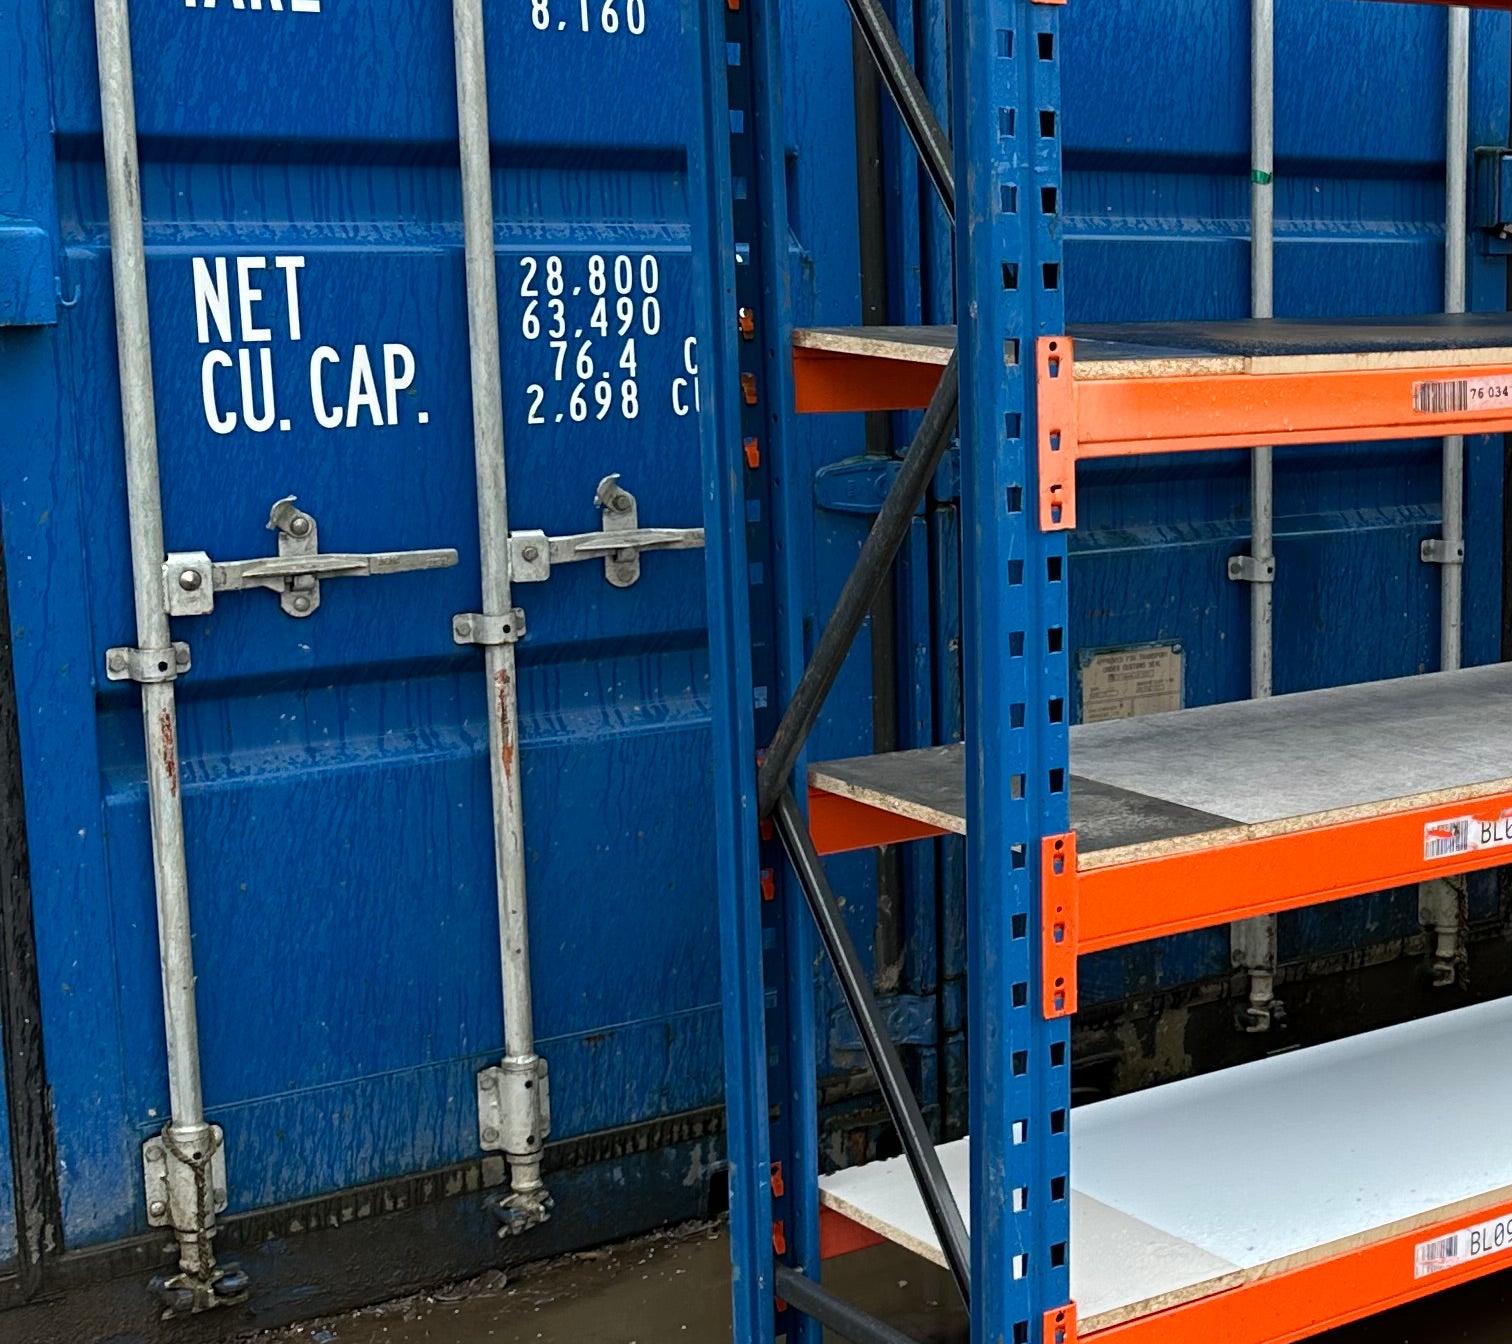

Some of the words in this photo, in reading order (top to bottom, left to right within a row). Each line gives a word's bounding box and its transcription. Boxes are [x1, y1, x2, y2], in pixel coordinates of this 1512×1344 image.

[192, 256, 305, 343] NET
[201, 349, 291, 434] CU.
[310, 344, 429, 427] CAP.
[550, 338, 637, 381] 76.4
[1470, 388, 1484, 399] 76
